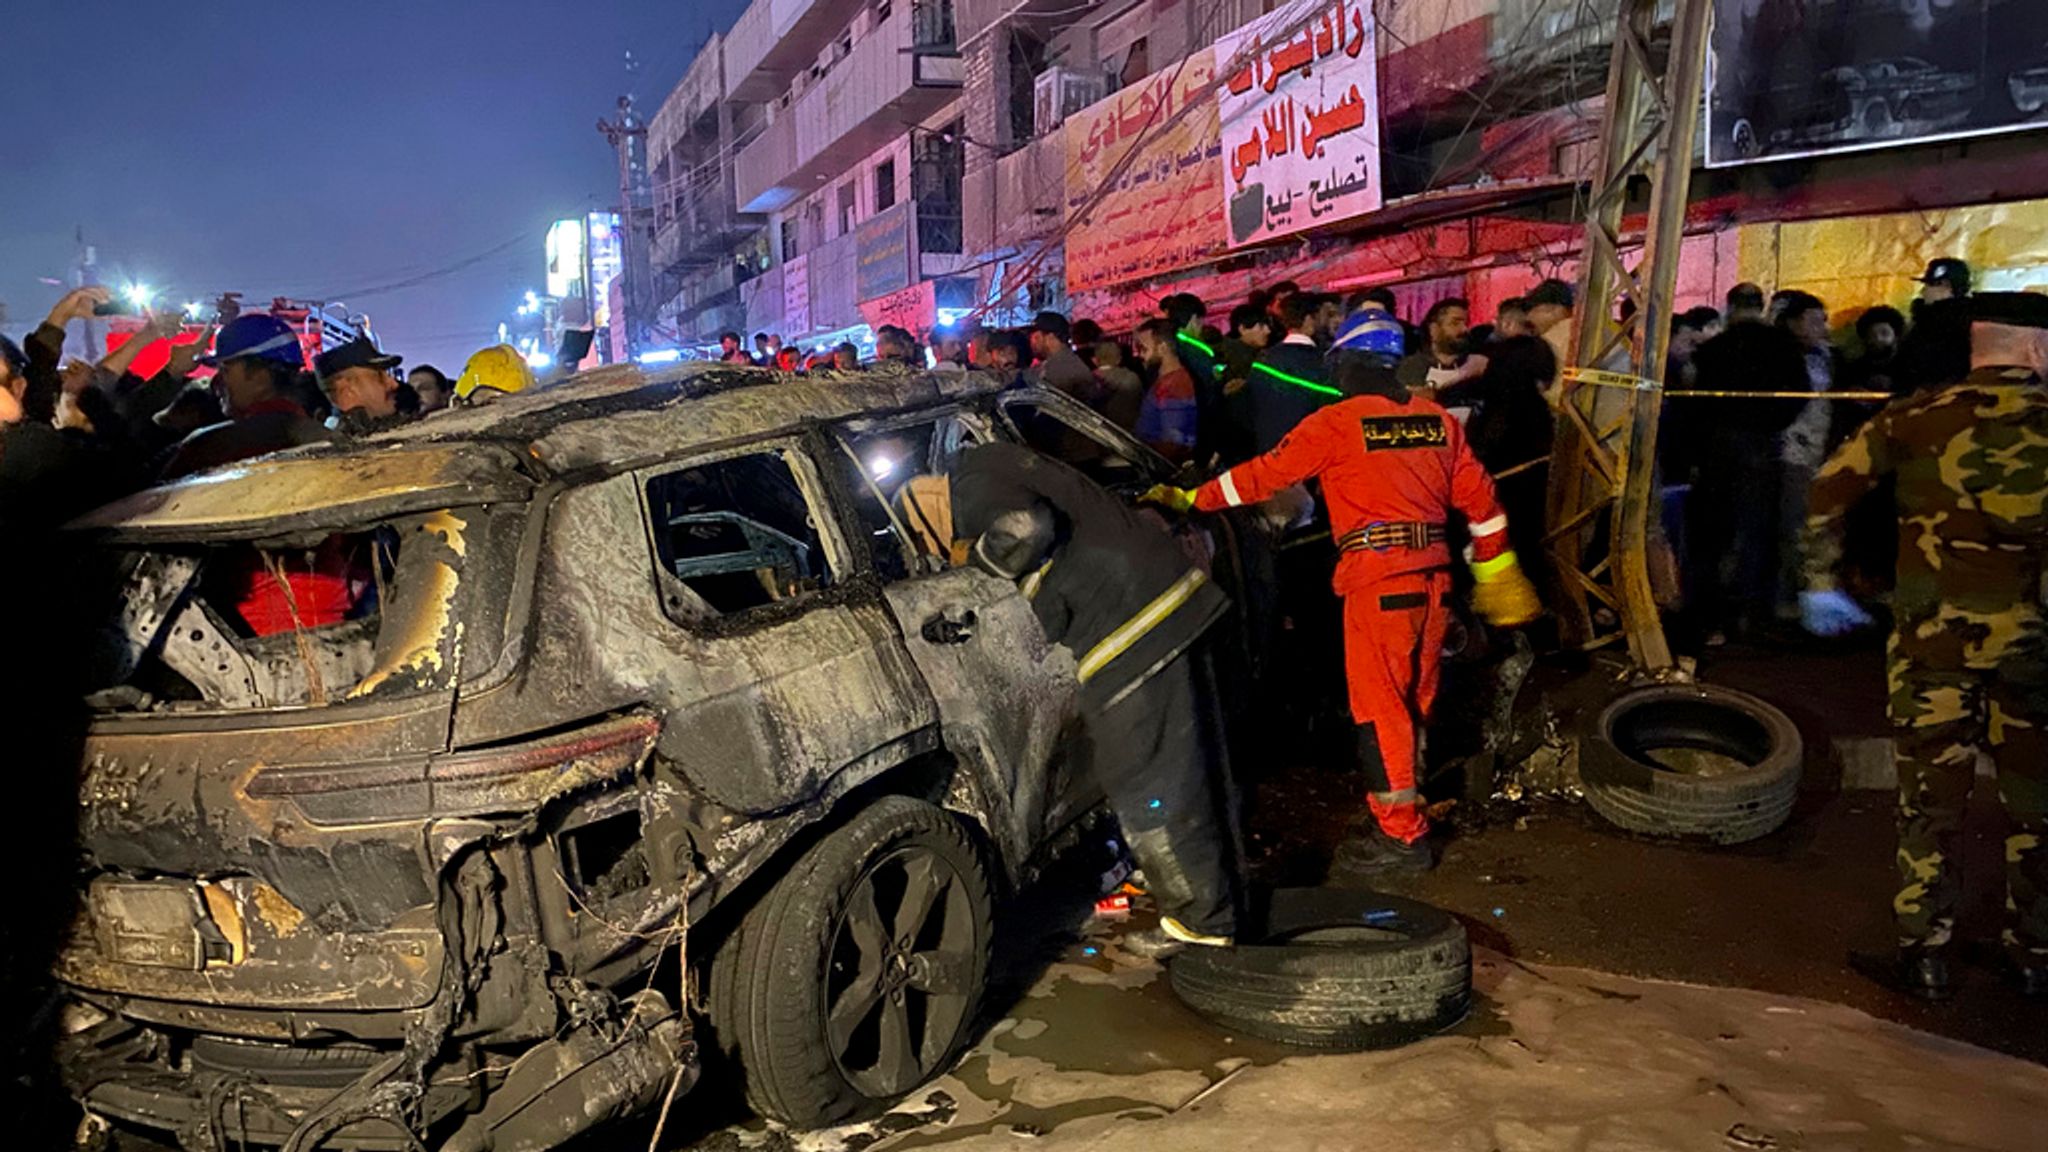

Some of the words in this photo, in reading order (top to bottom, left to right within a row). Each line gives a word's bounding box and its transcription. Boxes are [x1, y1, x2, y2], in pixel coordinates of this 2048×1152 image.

[1302, 84, 1366, 160] حسين
[1266, 188, 1293, 232] بيع
[1309, 154, 1368, 217] تصليح
